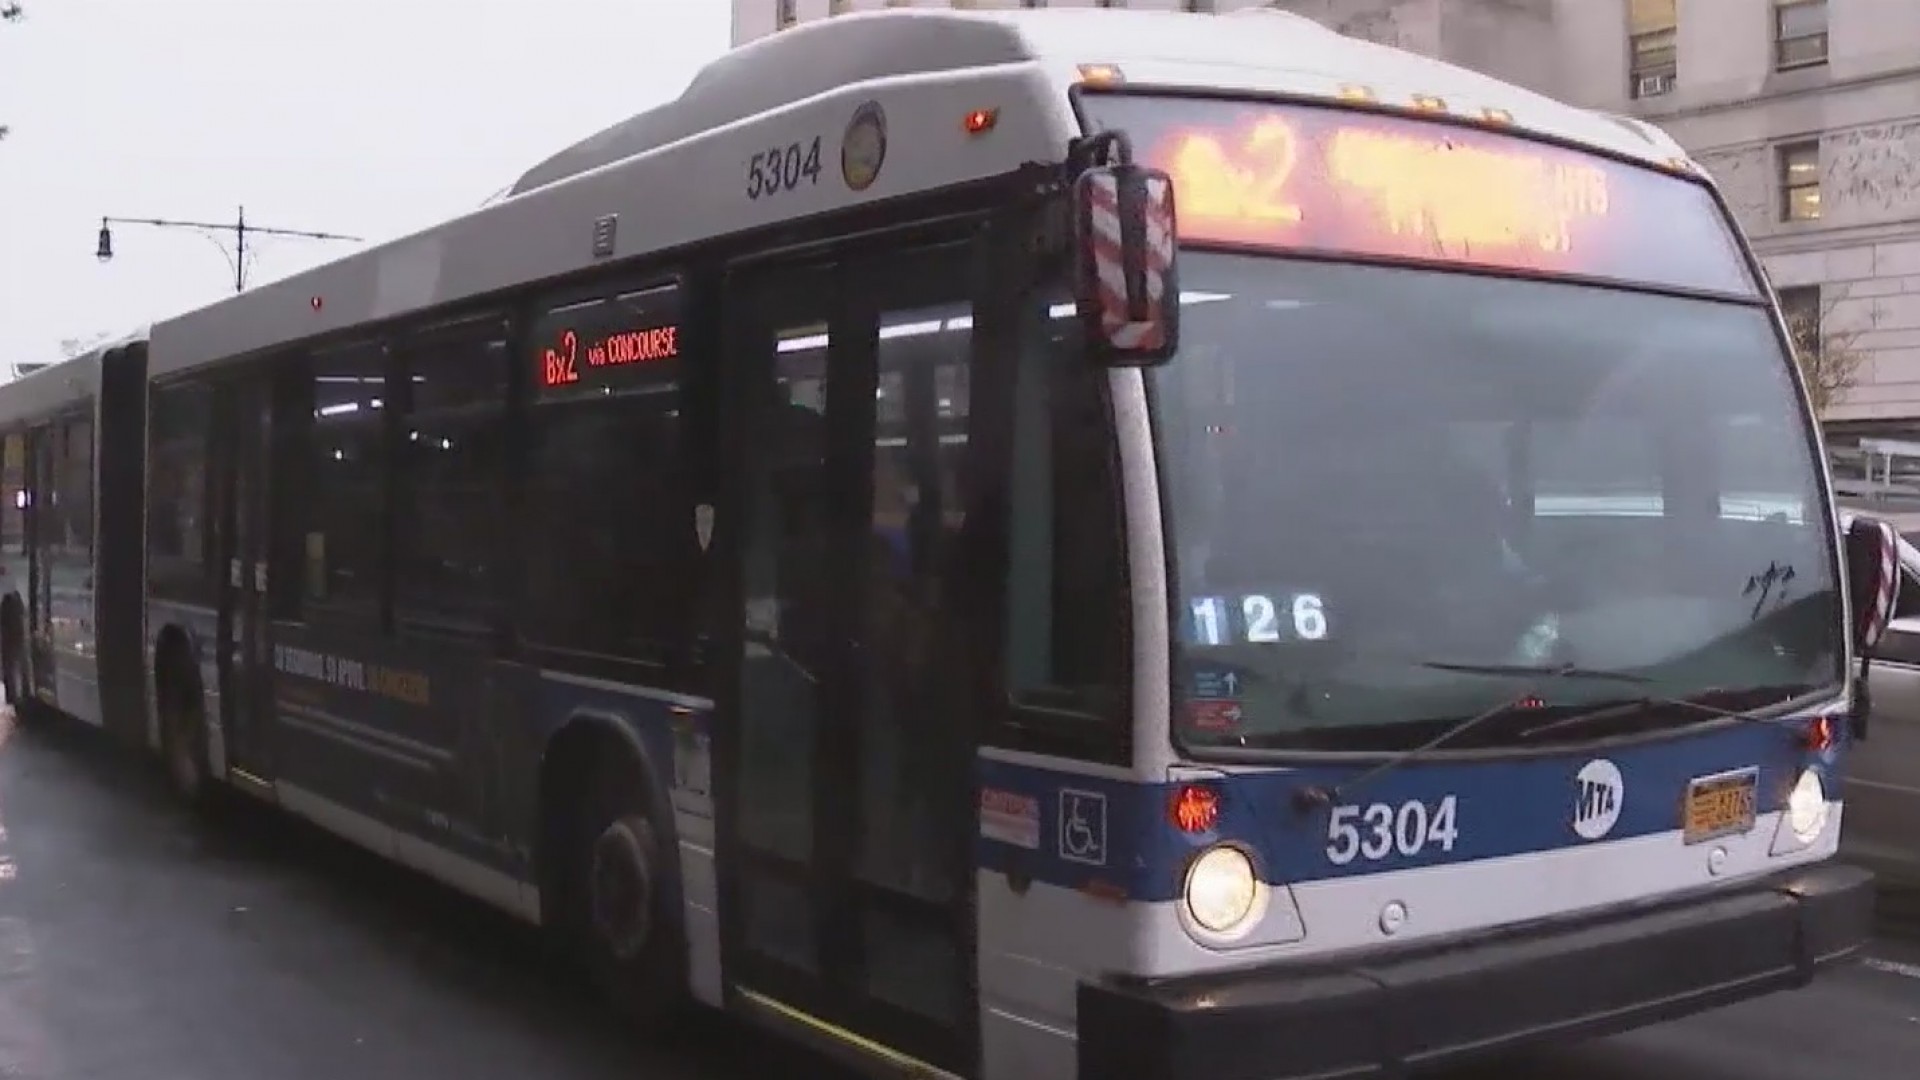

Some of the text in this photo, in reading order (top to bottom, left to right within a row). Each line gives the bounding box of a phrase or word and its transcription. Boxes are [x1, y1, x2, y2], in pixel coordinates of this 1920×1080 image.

[747, 134, 823, 201] 5304
[545, 330, 579, 385] Bx2
[607, 325, 678, 364] CONCOURSE
[1326, 794, 1458, 865] 5304
